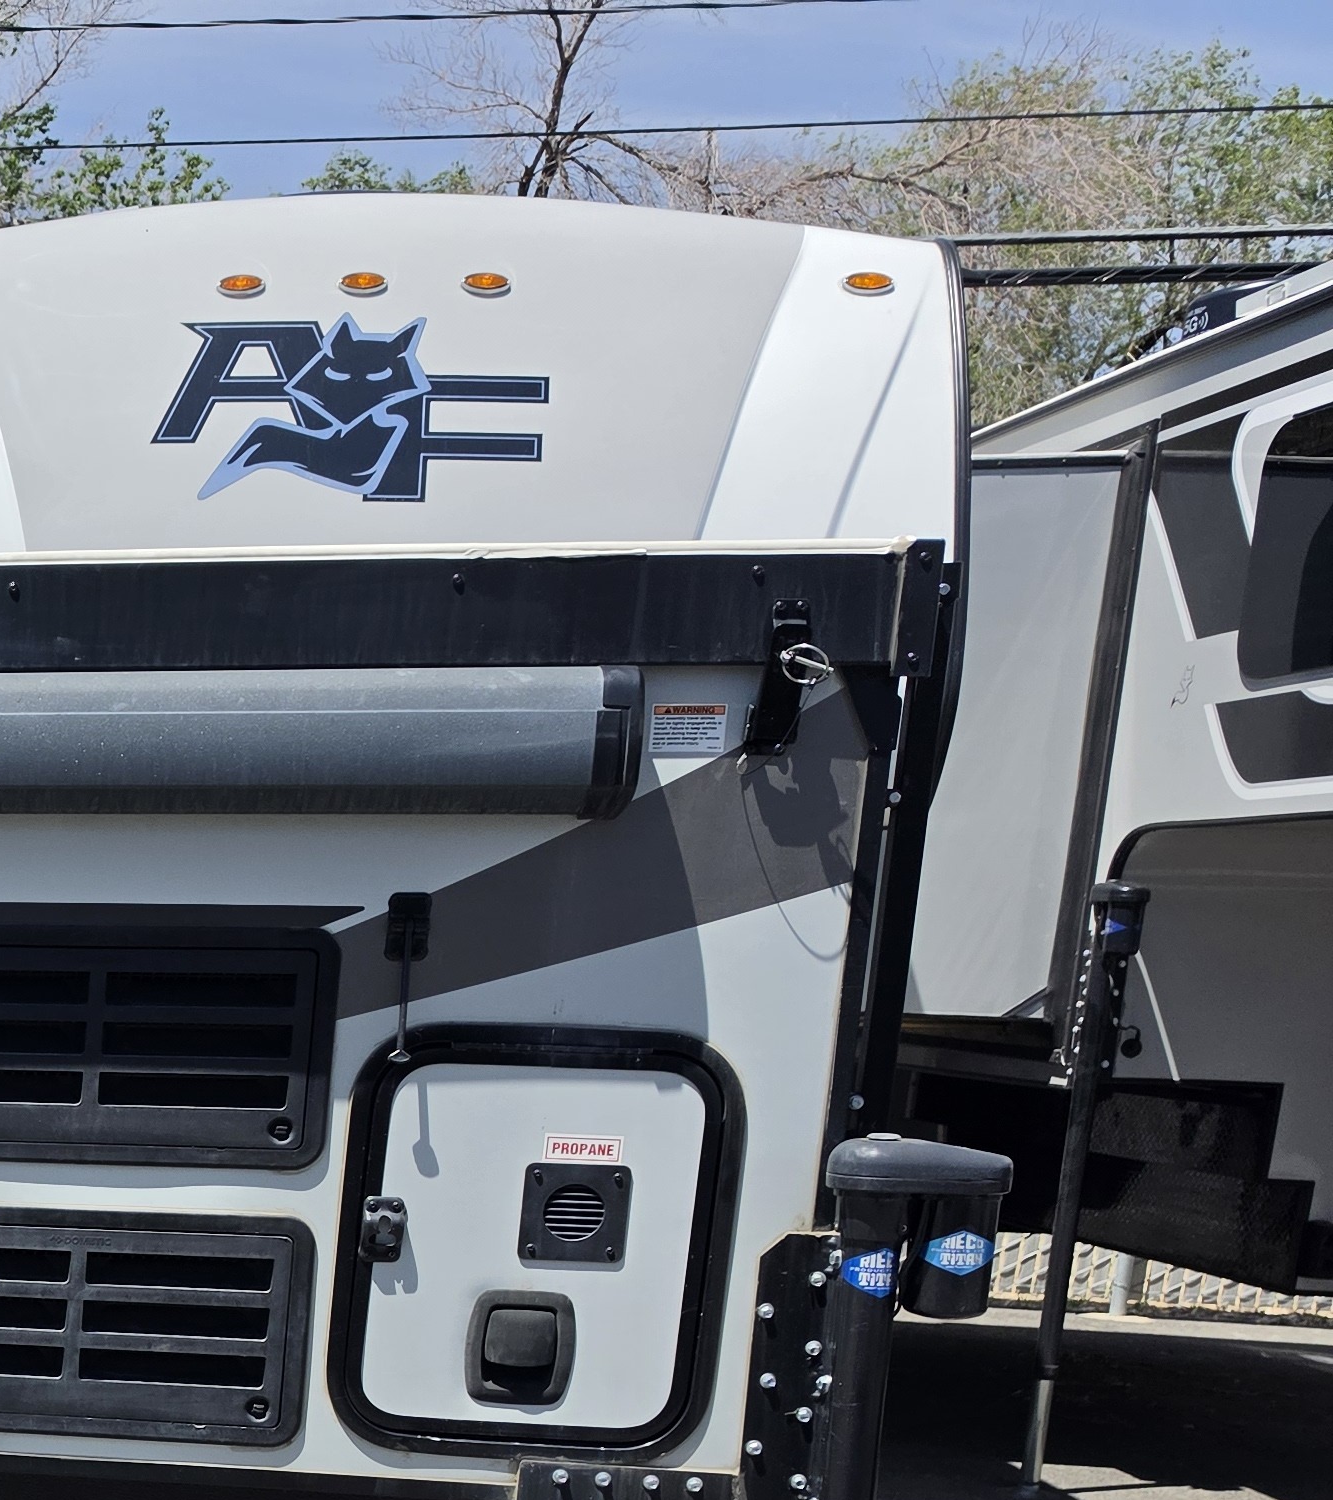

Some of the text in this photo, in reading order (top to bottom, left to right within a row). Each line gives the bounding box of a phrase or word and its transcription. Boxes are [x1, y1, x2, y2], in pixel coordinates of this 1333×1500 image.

[673, 706, 715, 714] WARNING
[552, 1142, 615, 1156] PROPANE
[940, 1233, 985, 1250] RIECO
